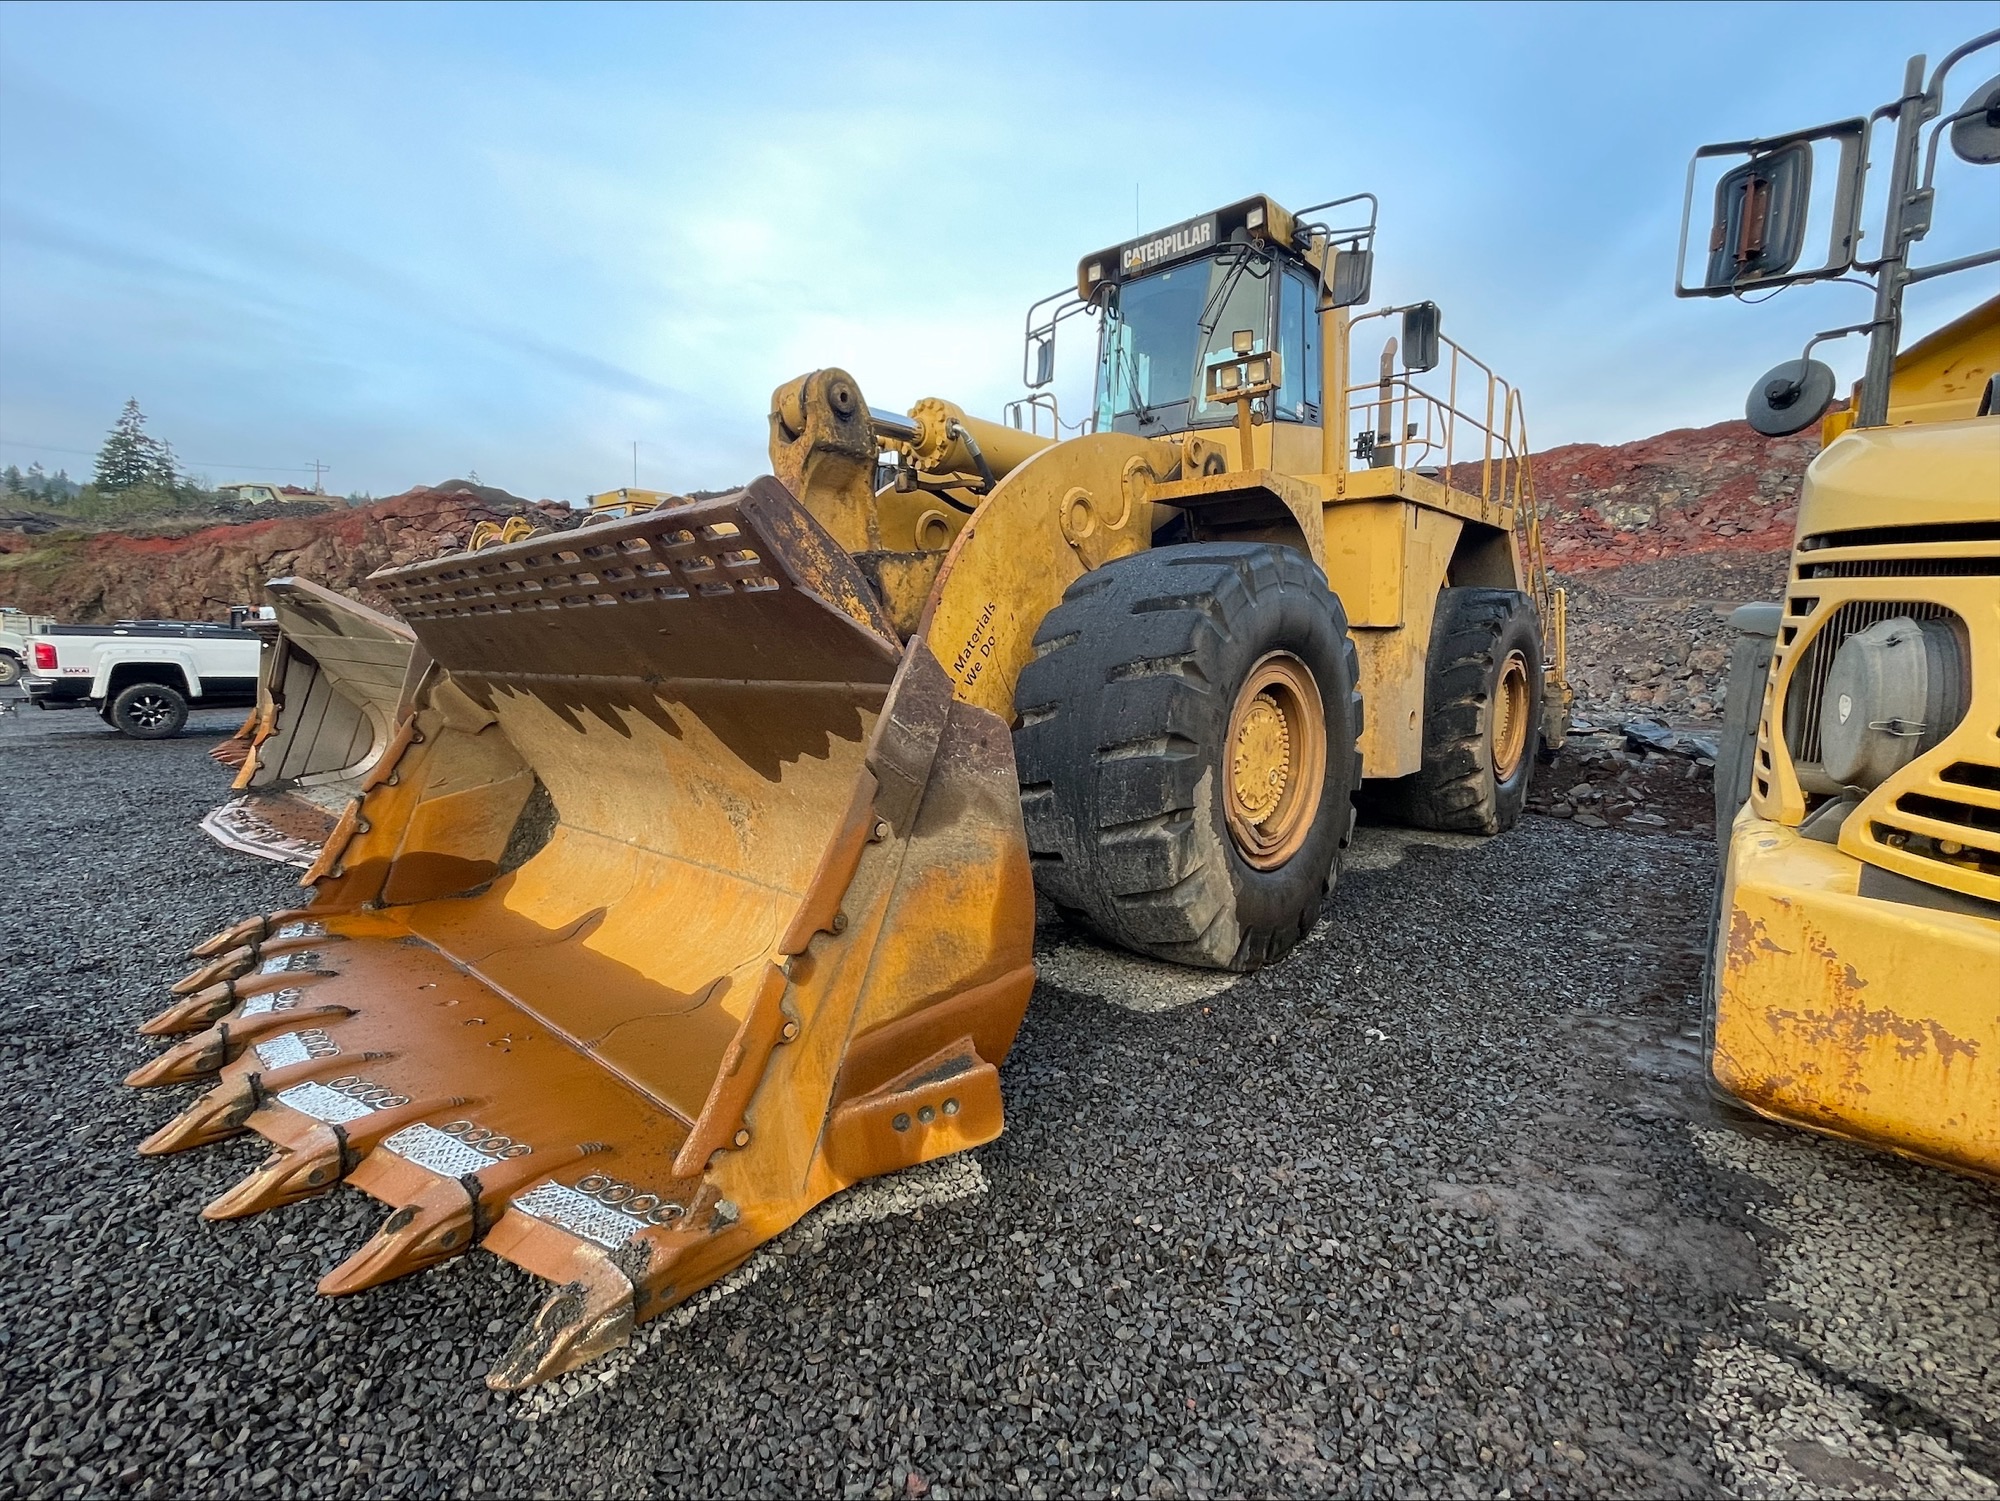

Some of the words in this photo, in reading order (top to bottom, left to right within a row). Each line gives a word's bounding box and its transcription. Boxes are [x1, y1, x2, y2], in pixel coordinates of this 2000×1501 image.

[1123, 222, 1211, 269] CATERPILLAR
[953, 601, 996, 673] Materials
[964, 661, 983, 687] We
